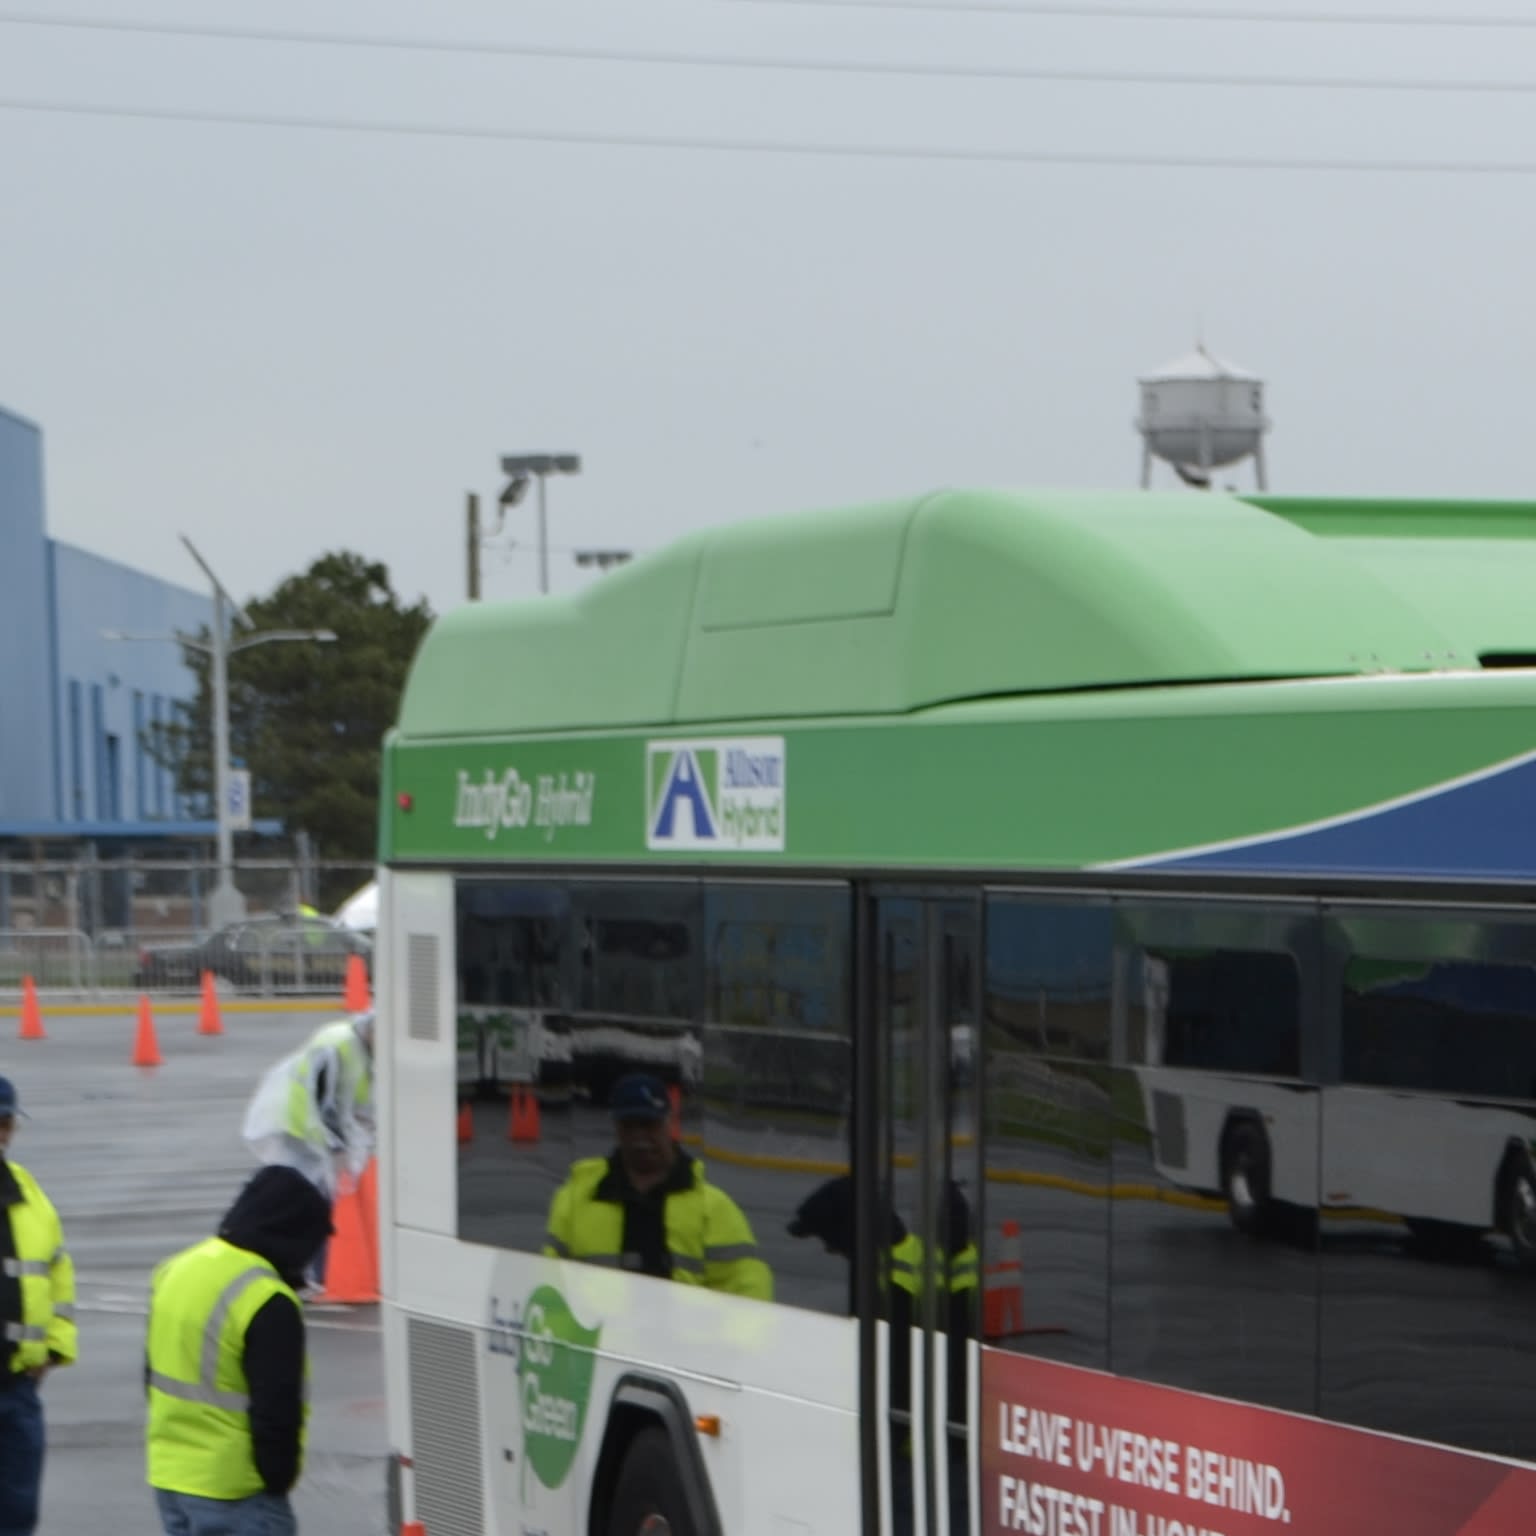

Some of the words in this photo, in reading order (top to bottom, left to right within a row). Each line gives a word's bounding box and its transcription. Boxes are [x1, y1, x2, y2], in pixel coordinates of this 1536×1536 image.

[725, 748, 781, 788] Allison
[453, 766, 531, 842] IndyGo
[534, 771, 596, 844] Hybrid
[723, 794, 780, 848] Hybrid
[999, 1402, 1072, 1466] LEAVE
[1076, 1425, 1180, 1491] U-VERSE
[1186, 1449, 1291, 1523] BEHIND.
